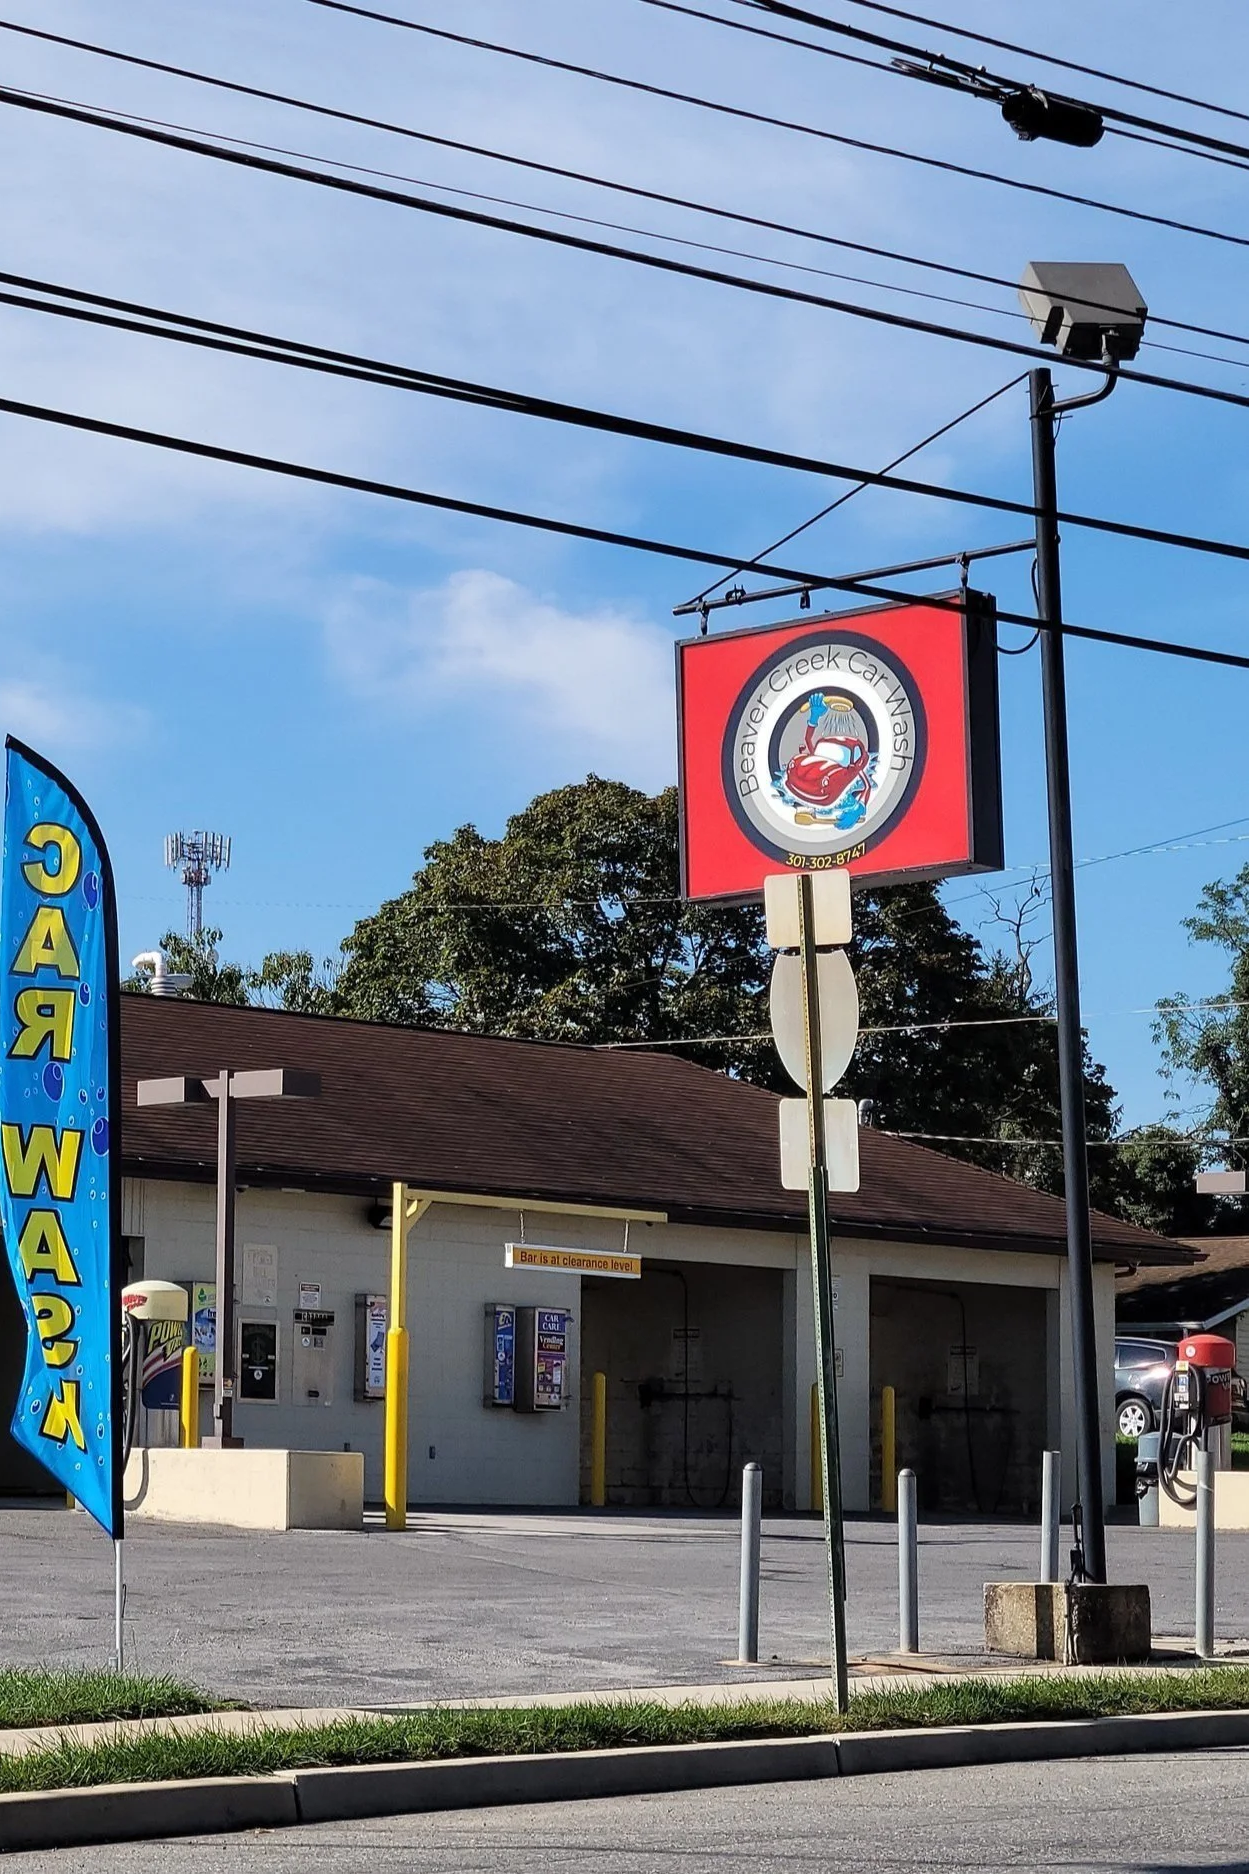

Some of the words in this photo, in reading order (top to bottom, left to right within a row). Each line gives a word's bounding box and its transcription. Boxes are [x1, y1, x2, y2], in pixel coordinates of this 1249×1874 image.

[739, 693, 768, 798] Beaver
[768, 645, 840, 693] Creek
[848, 652, 889, 685] Car
[886, 684, 914, 772] Wash
[786, 843, 867, 870] 301-302-8747
[520, 1251, 538, 1263] Bar
[540, 1252, 549, 1264] is
[551, 1254, 560, 1264] at
[562, 1255, 608, 1269] clearance
[611, 1258, 633, 1272] level
[544, 1314, 560, 1323] CAR
[539, 1335, 564, 1347] Vending
